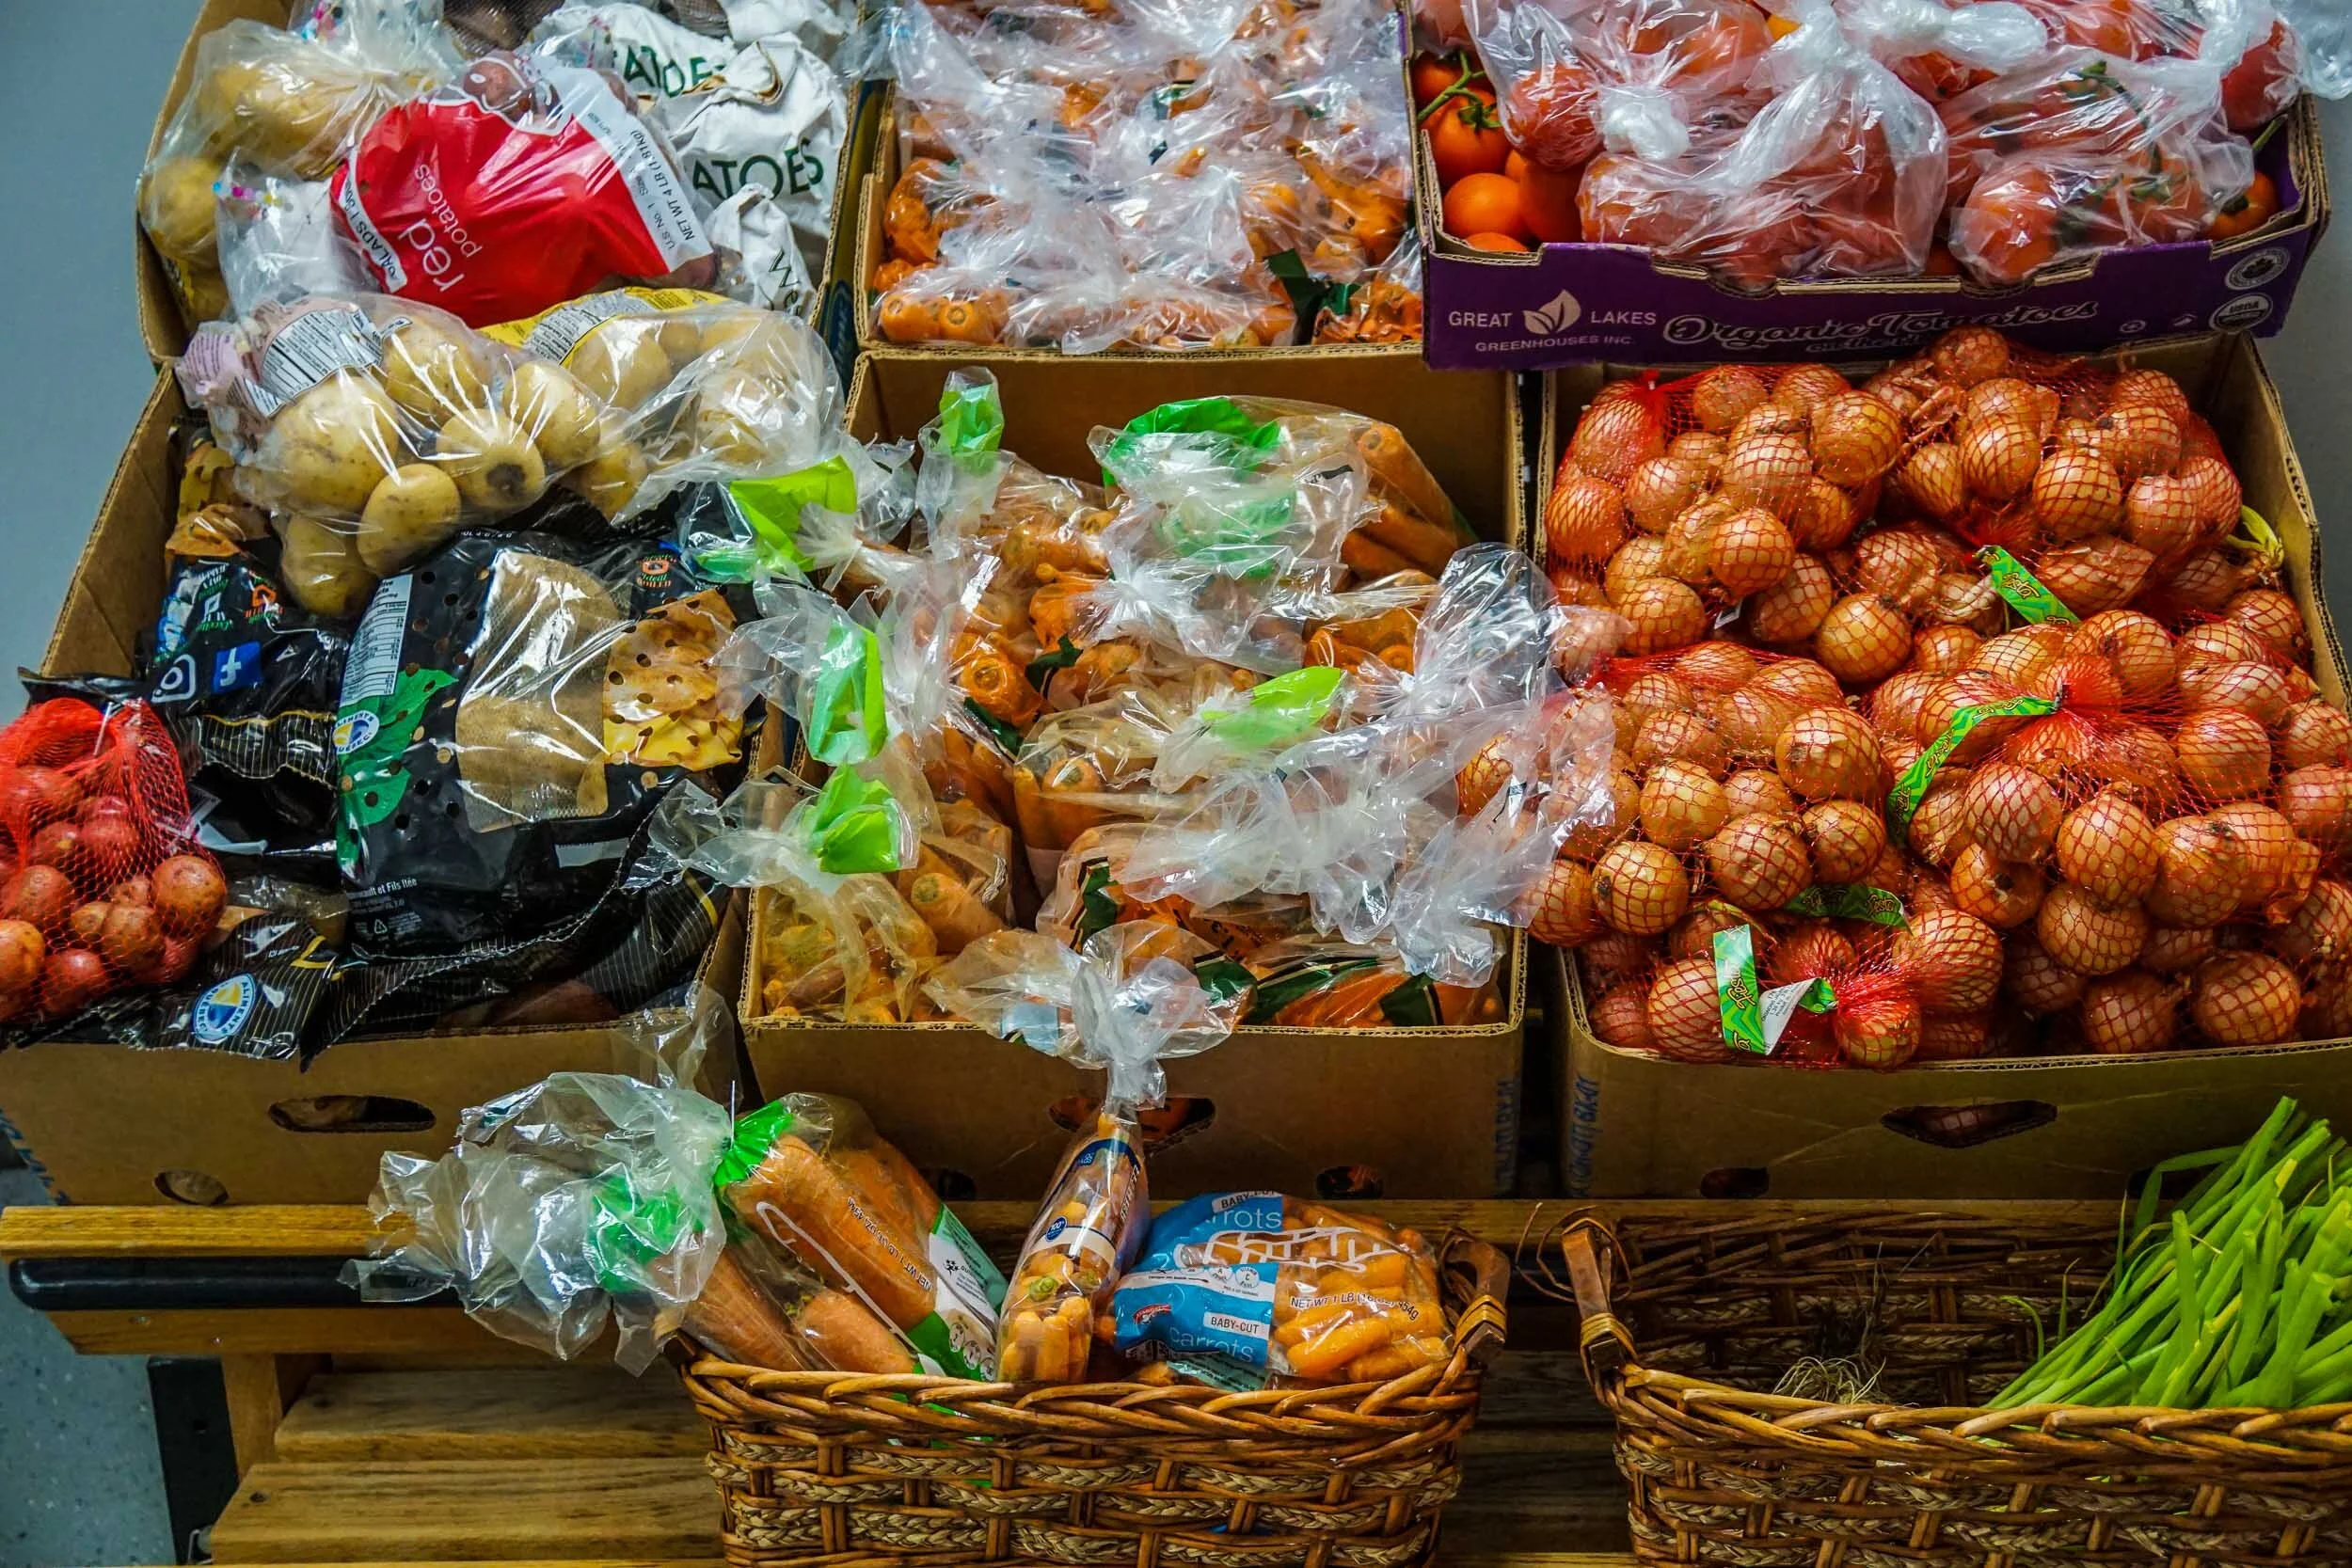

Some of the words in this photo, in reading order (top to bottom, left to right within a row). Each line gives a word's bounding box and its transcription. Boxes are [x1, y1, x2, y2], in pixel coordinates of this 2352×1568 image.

[654, 173, 669, 189] LB
[415, 164, 483, 258] potatoes
[667, 199, 683, 217] WT
[676, 219, 695, 241] NET
[398, 218, 465, 292] red
[1448, 311, 1513, 327] GREAT
[1591, 310, 1657, 325] LAKES
[1662, 314, 1870, 351] Organic
[1475, 335, 1599, 352] GREENHOUSES
[387, 879, 402, 893] Fils
[904, 1261, 920, 1278] WT
[915, 1274, 933, 1292] NET
[1291, 1296, 1312, 1308] NET
[1314, 1296, 1328, 1307] WT
[1341, 1292, 1355, 1303] LB
[1398, 1301, 1419, 1321] 454g
[1211, 1316, 1260, 1334] BABY-CUT
